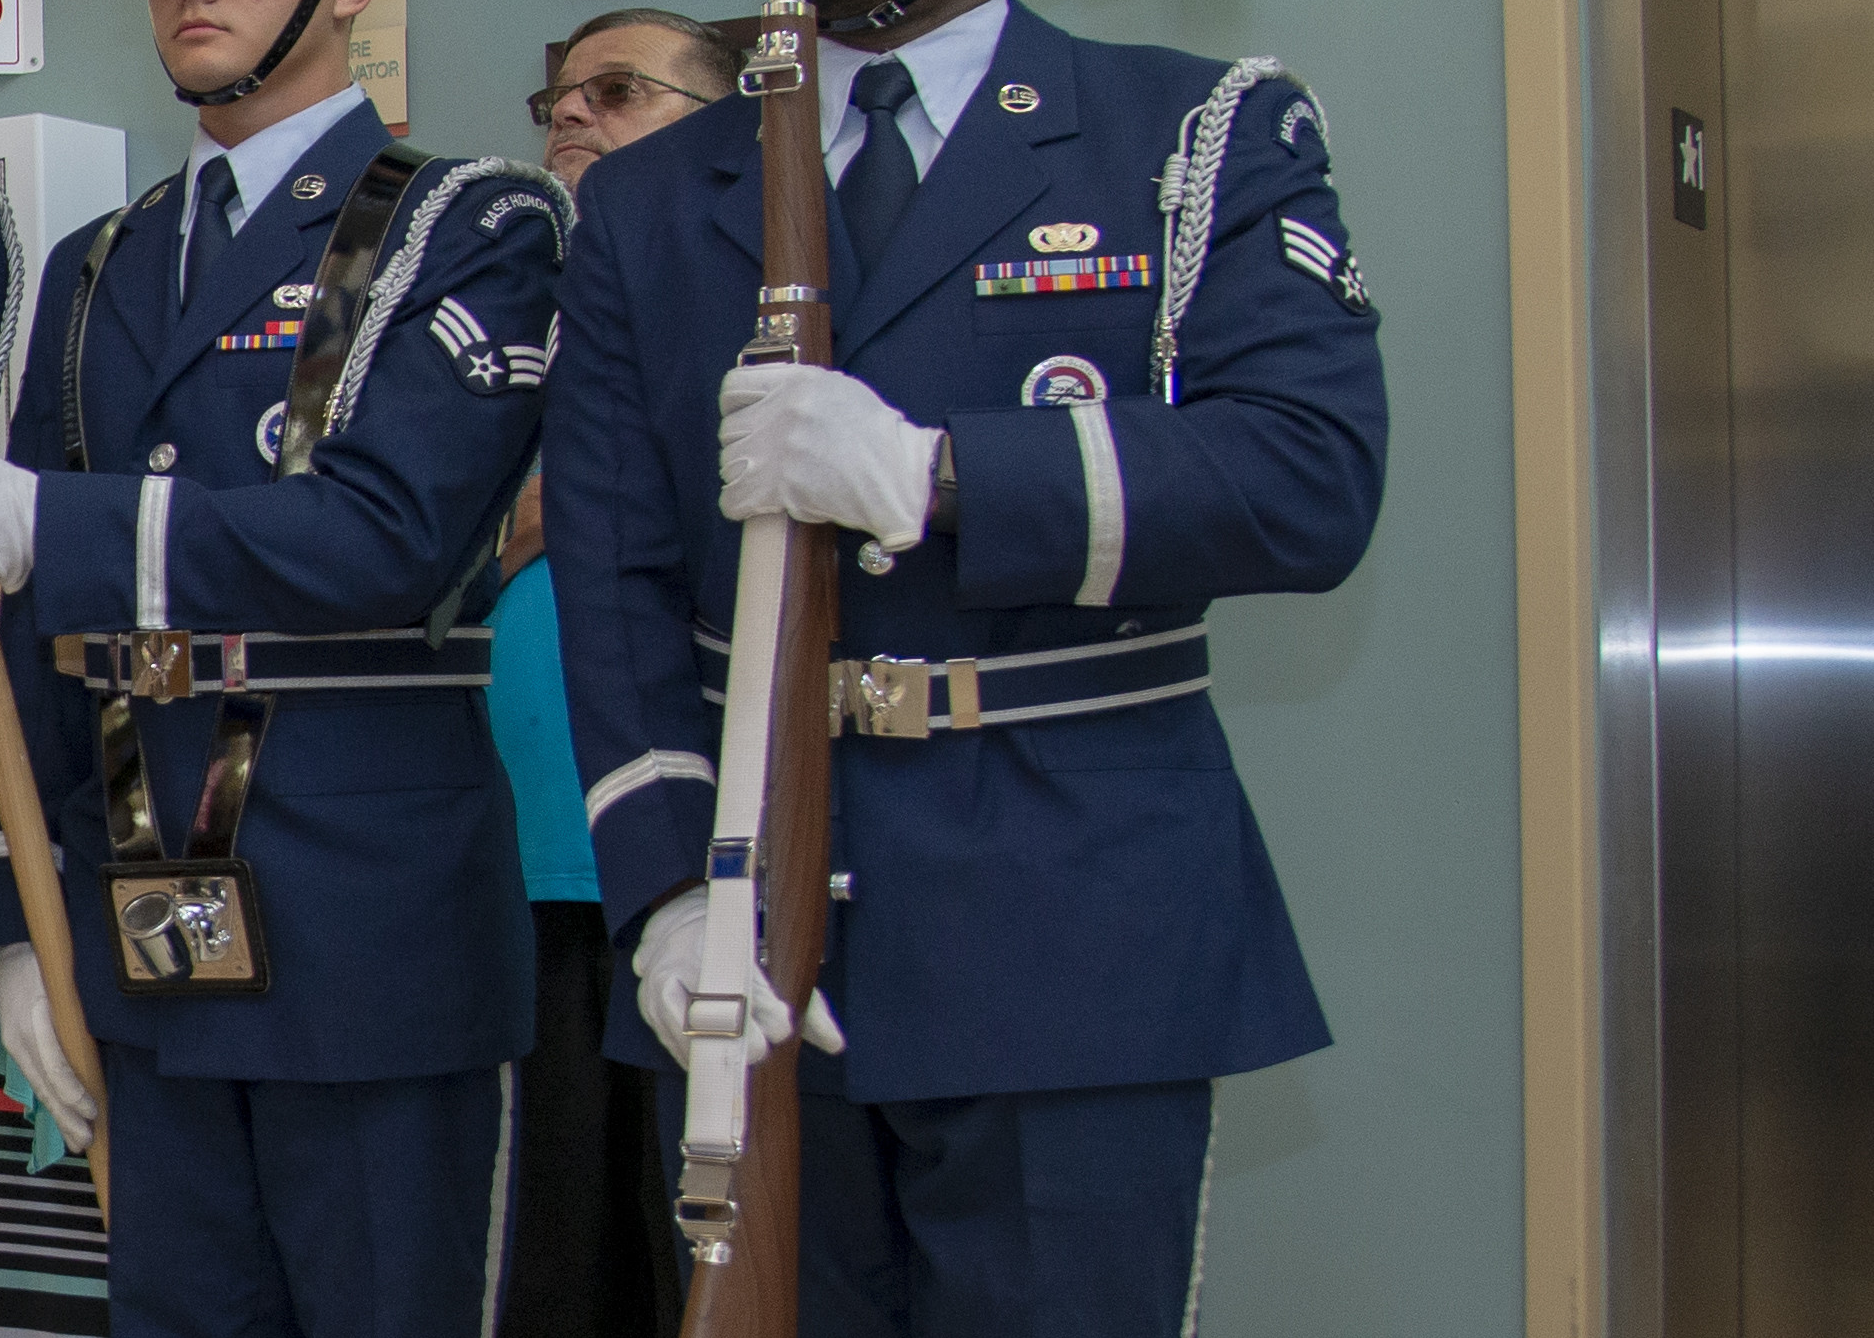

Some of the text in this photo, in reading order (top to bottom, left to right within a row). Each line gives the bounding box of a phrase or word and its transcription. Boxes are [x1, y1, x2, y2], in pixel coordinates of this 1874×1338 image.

[349, 60, 400, 81] VATOR
[1694, 130, 1704, 191] 1
[479, 197, 513, 230] BASE
